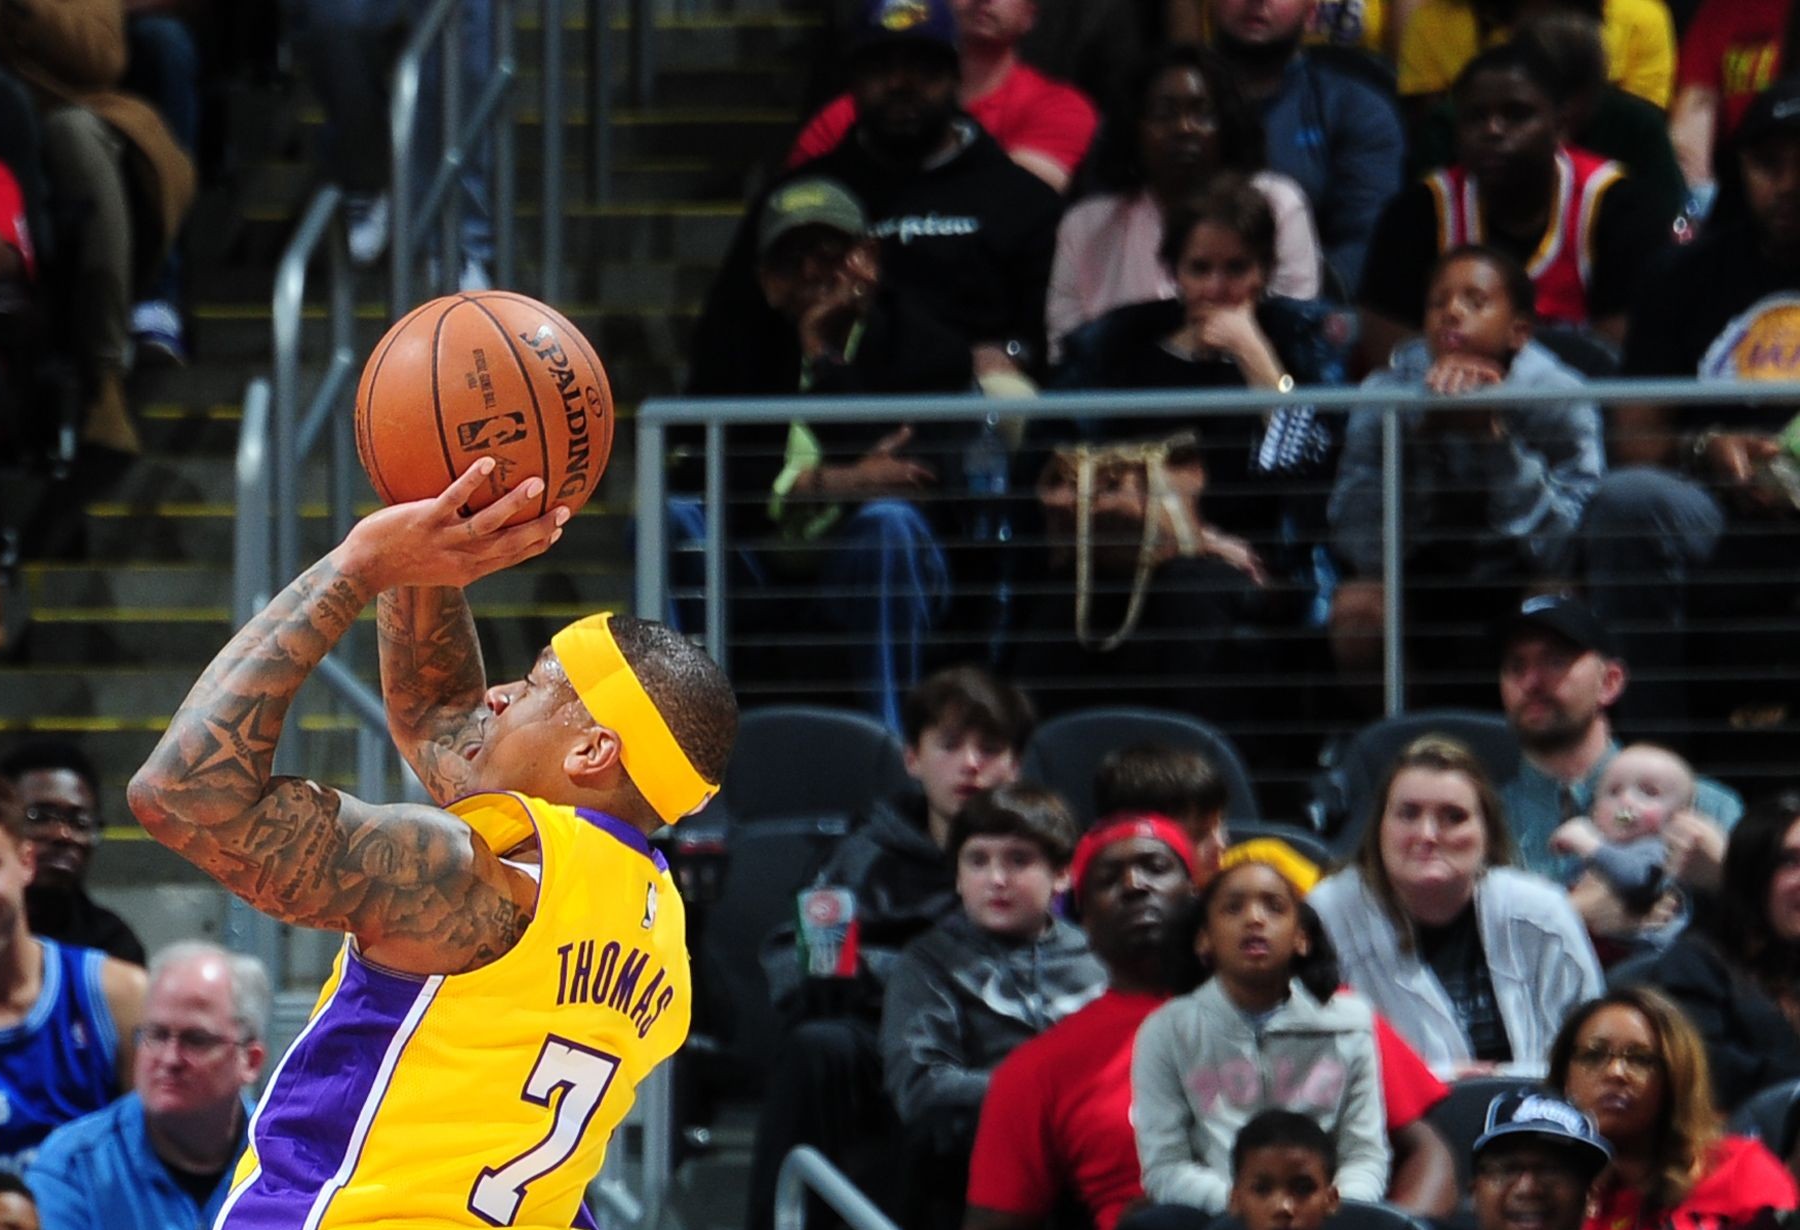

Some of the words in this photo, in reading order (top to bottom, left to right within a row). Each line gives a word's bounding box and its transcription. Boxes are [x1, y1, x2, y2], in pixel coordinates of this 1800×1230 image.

[518, 324, 590, 501] SPALDING
[556, 939, 674, 1040] THOMAS
[467, 1032, 622, 1228] 7
